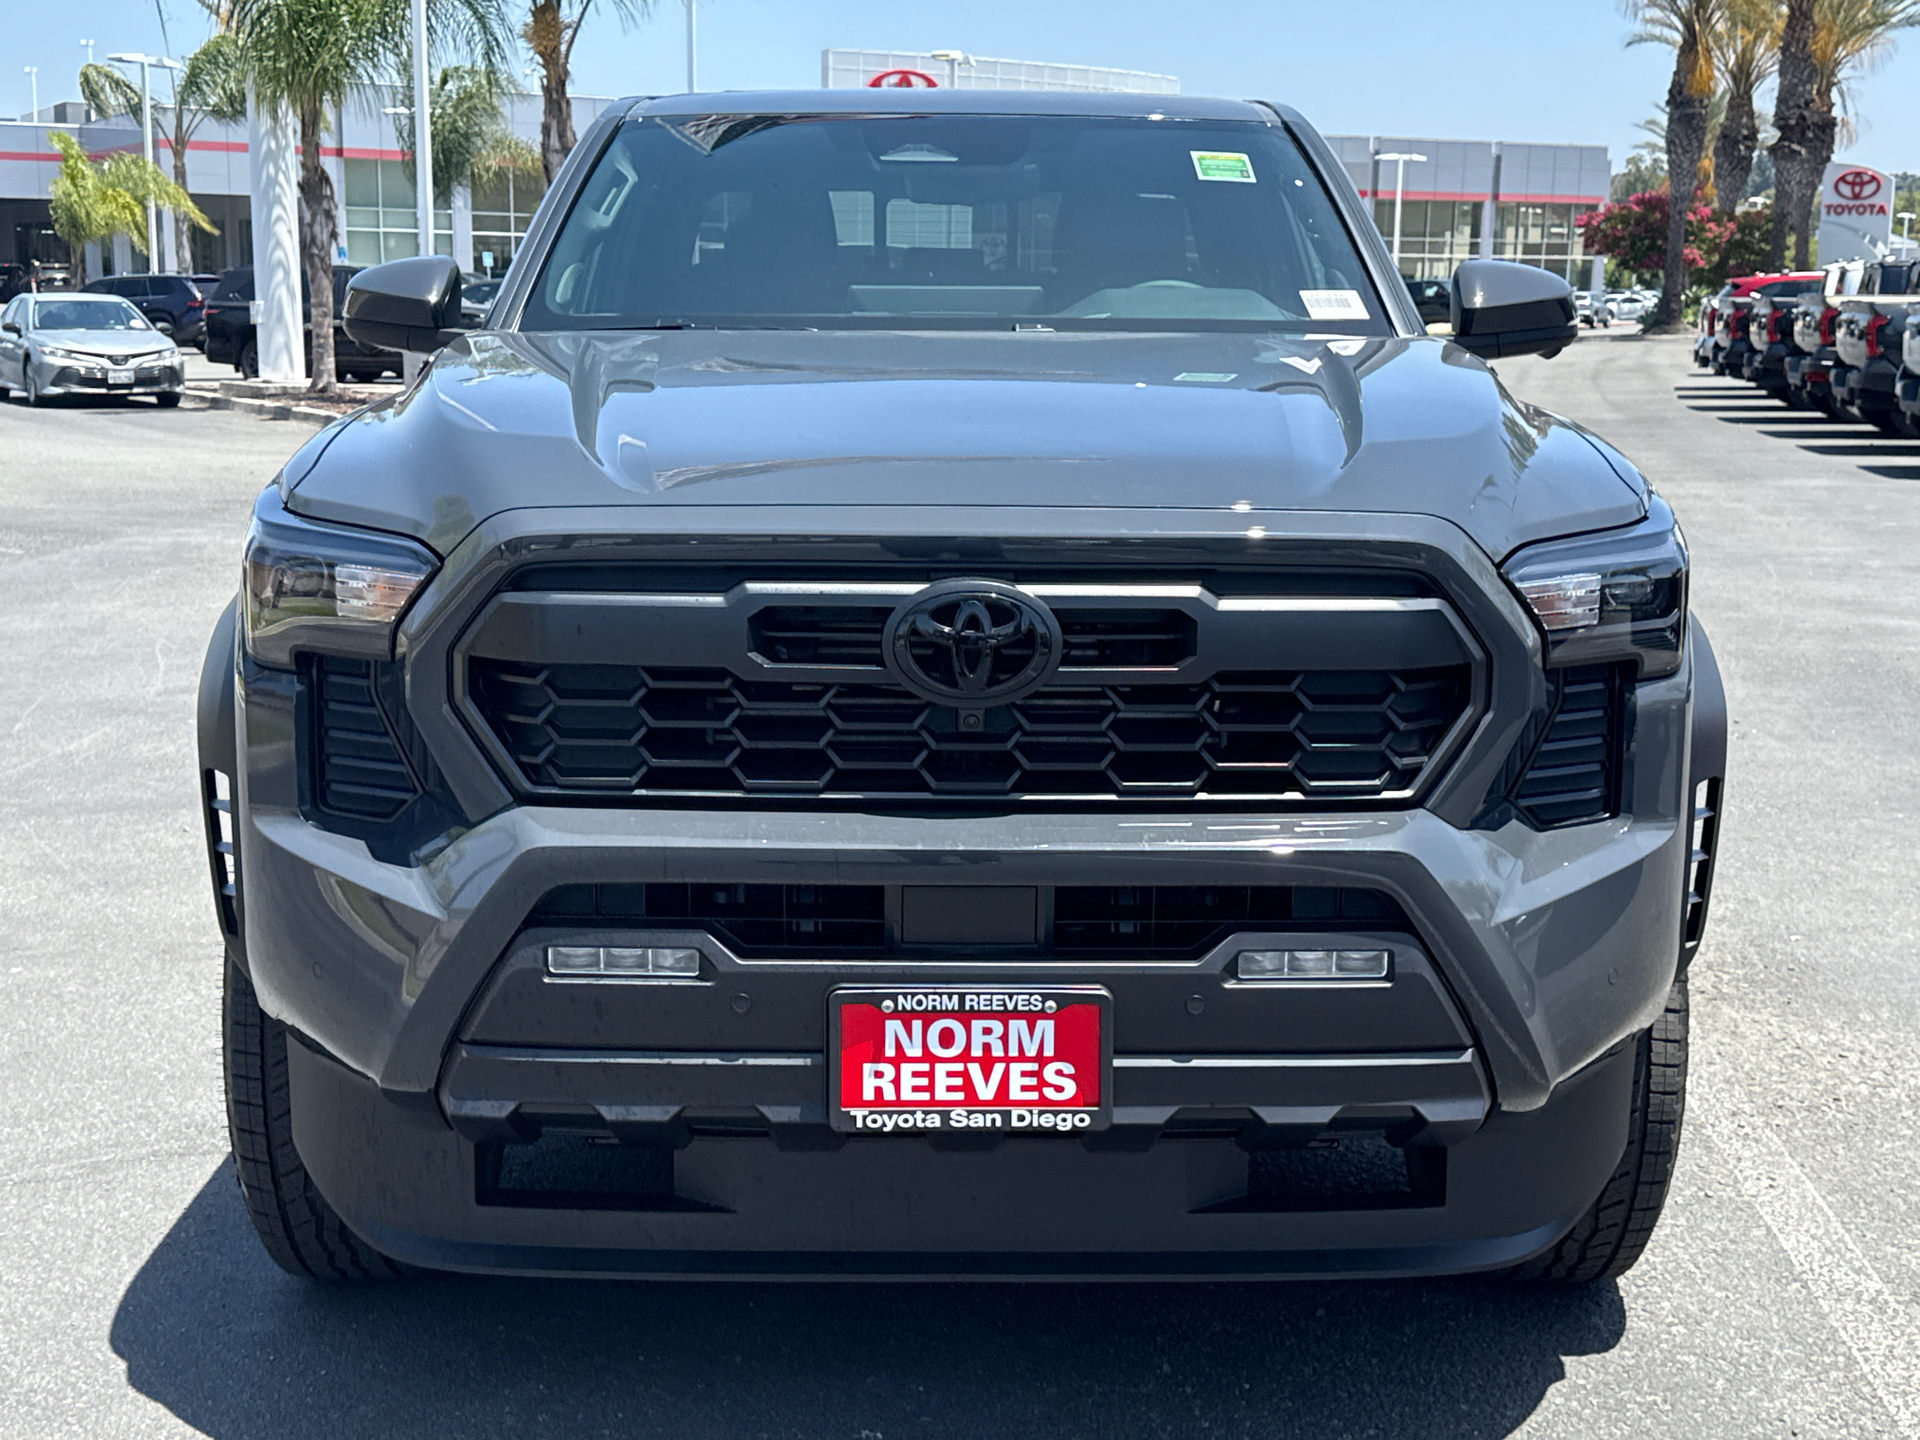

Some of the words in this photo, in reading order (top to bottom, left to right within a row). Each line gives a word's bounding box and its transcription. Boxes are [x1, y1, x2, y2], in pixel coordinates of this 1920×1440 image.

[1825, 203, 1887, 216] TOYOTA
[897, 995, 958, 1011] NORM
[965, 995, 1043, 1011] REEVES
[884, 1019, 1055, 1057] NORM
[861, 1062, 1077, 1101] REEVES
[850, 1109, 941, 1131] Toyota
[949, 1109, 1002, 1127] San
[1010, 1109, 1091, 1130] Diego
